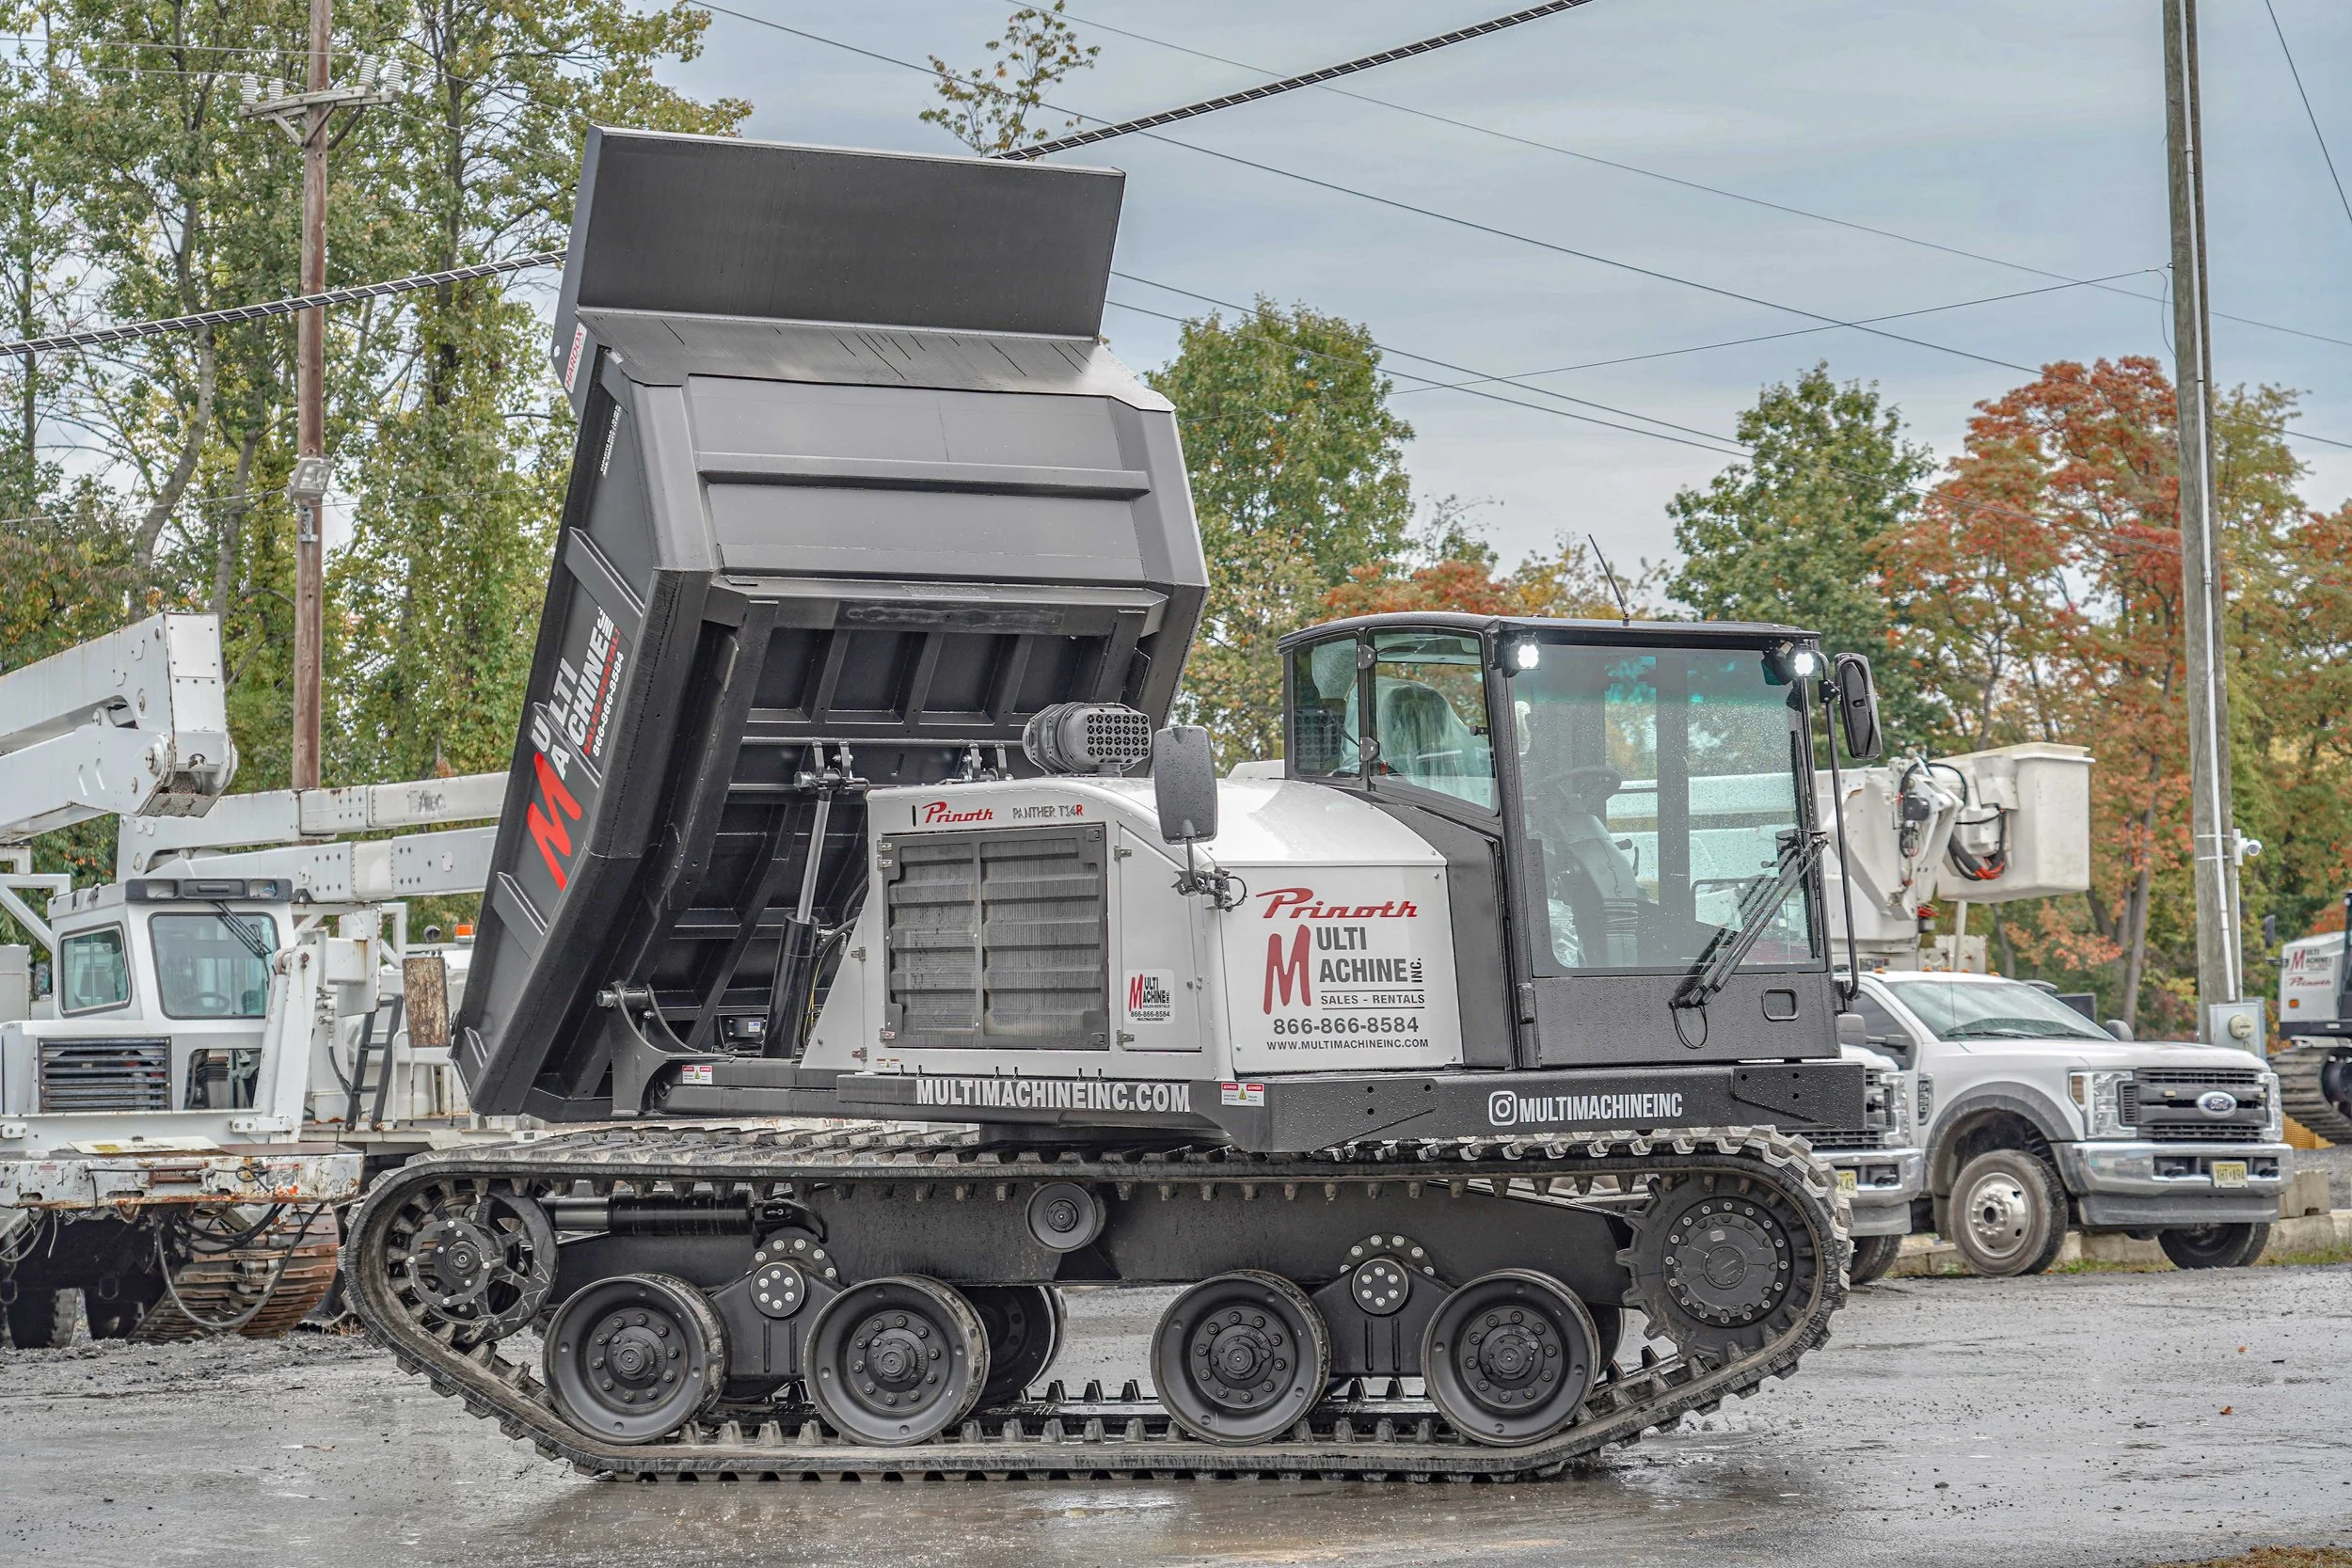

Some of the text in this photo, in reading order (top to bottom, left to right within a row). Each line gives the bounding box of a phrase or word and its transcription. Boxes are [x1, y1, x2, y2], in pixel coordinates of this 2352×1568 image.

[565, 330, 583, 388] HARDOX
[592, 651, 625, 757] 866-866-8584
[922, 800, 993, 824] Prinoth
[1012, 806, 1057, 819] PANTHER
[1255, 887, 1418, 919] Prinoth
[1409, 958, 1423, 983] INC.
[1320, 994, 1359, 1006] SALES
[1372, 993, 1425, 1005] RENTALS
[1273, 1016, 1419, 1036] 866-866-8584
[1266, 1038, 1429, 1051] WWW.MULTIMACHINEINC.COM
[915, 1079, 1190, 1113] MULTIMACHINEINC.COM
[1518, 1092, 1683, 1123] MULTIMACHINEINC
